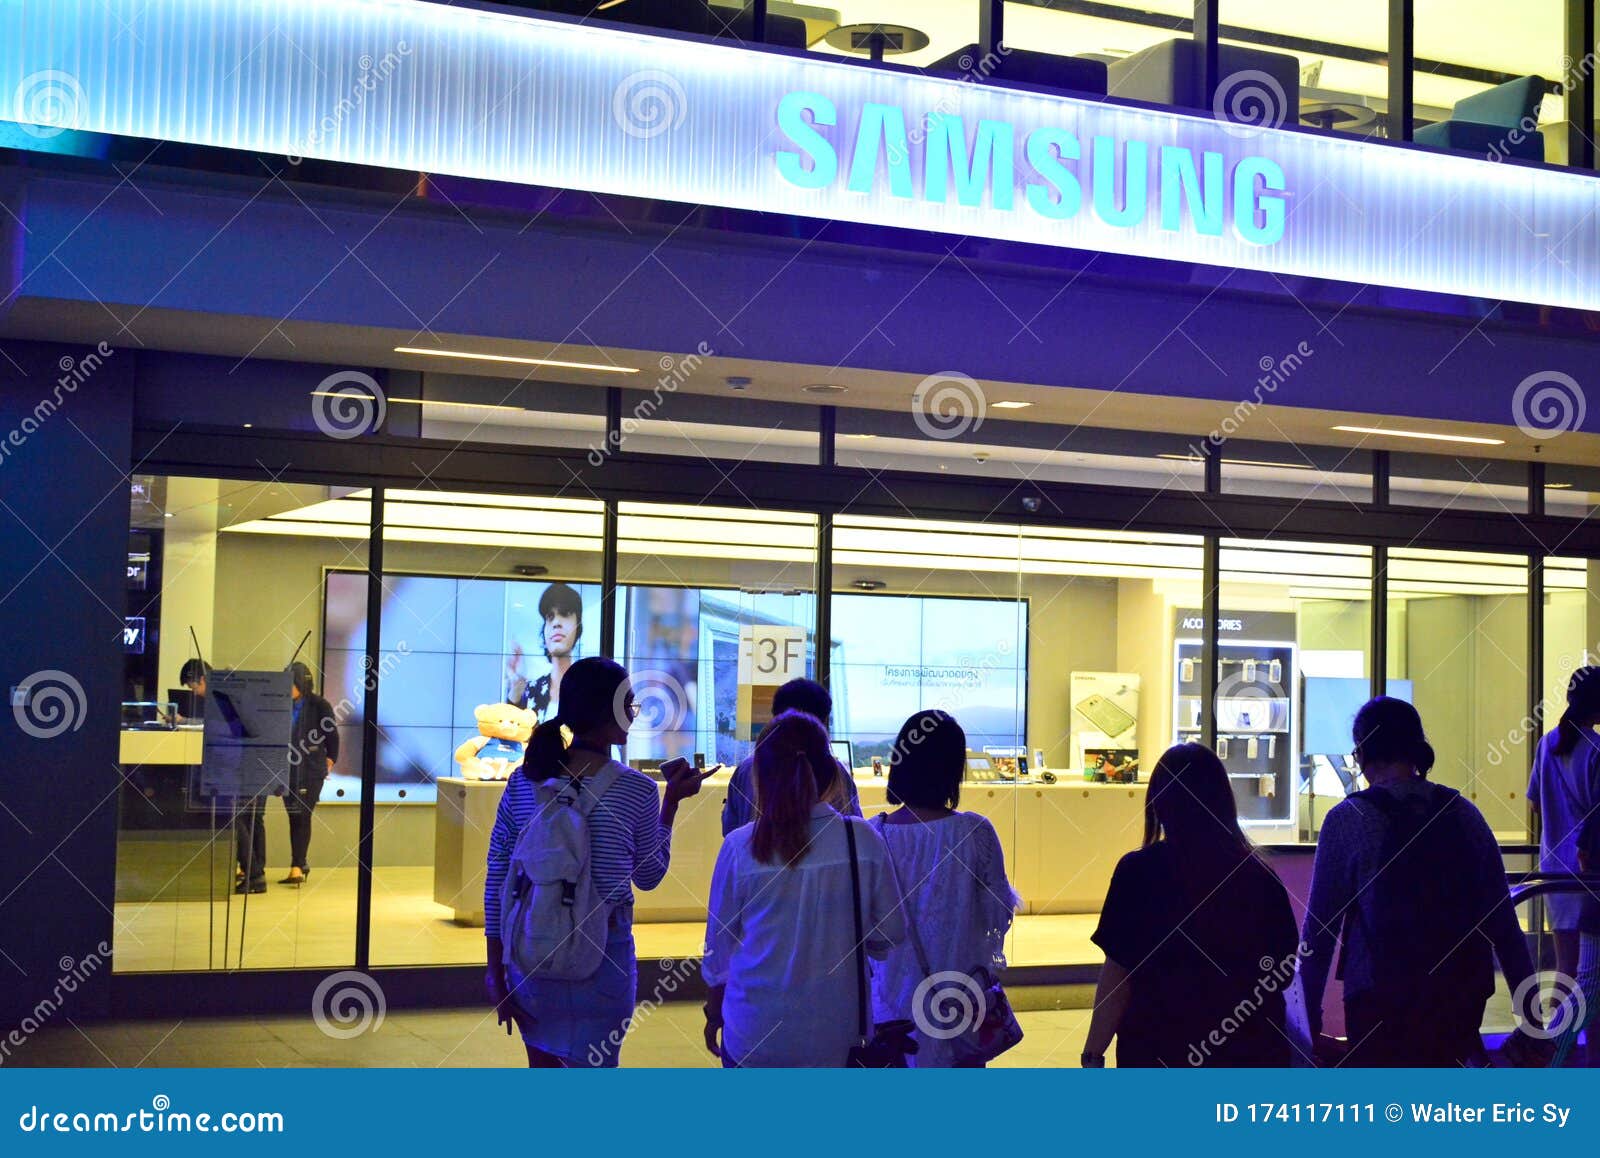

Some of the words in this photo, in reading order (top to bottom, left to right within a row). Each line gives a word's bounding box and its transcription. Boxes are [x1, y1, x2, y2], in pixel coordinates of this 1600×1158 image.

[776, 91, 1286, 246] SAMSUNG
[1183, 618, 1242, 631] ACCORIES
[757, 638, 803, 674] 3F
